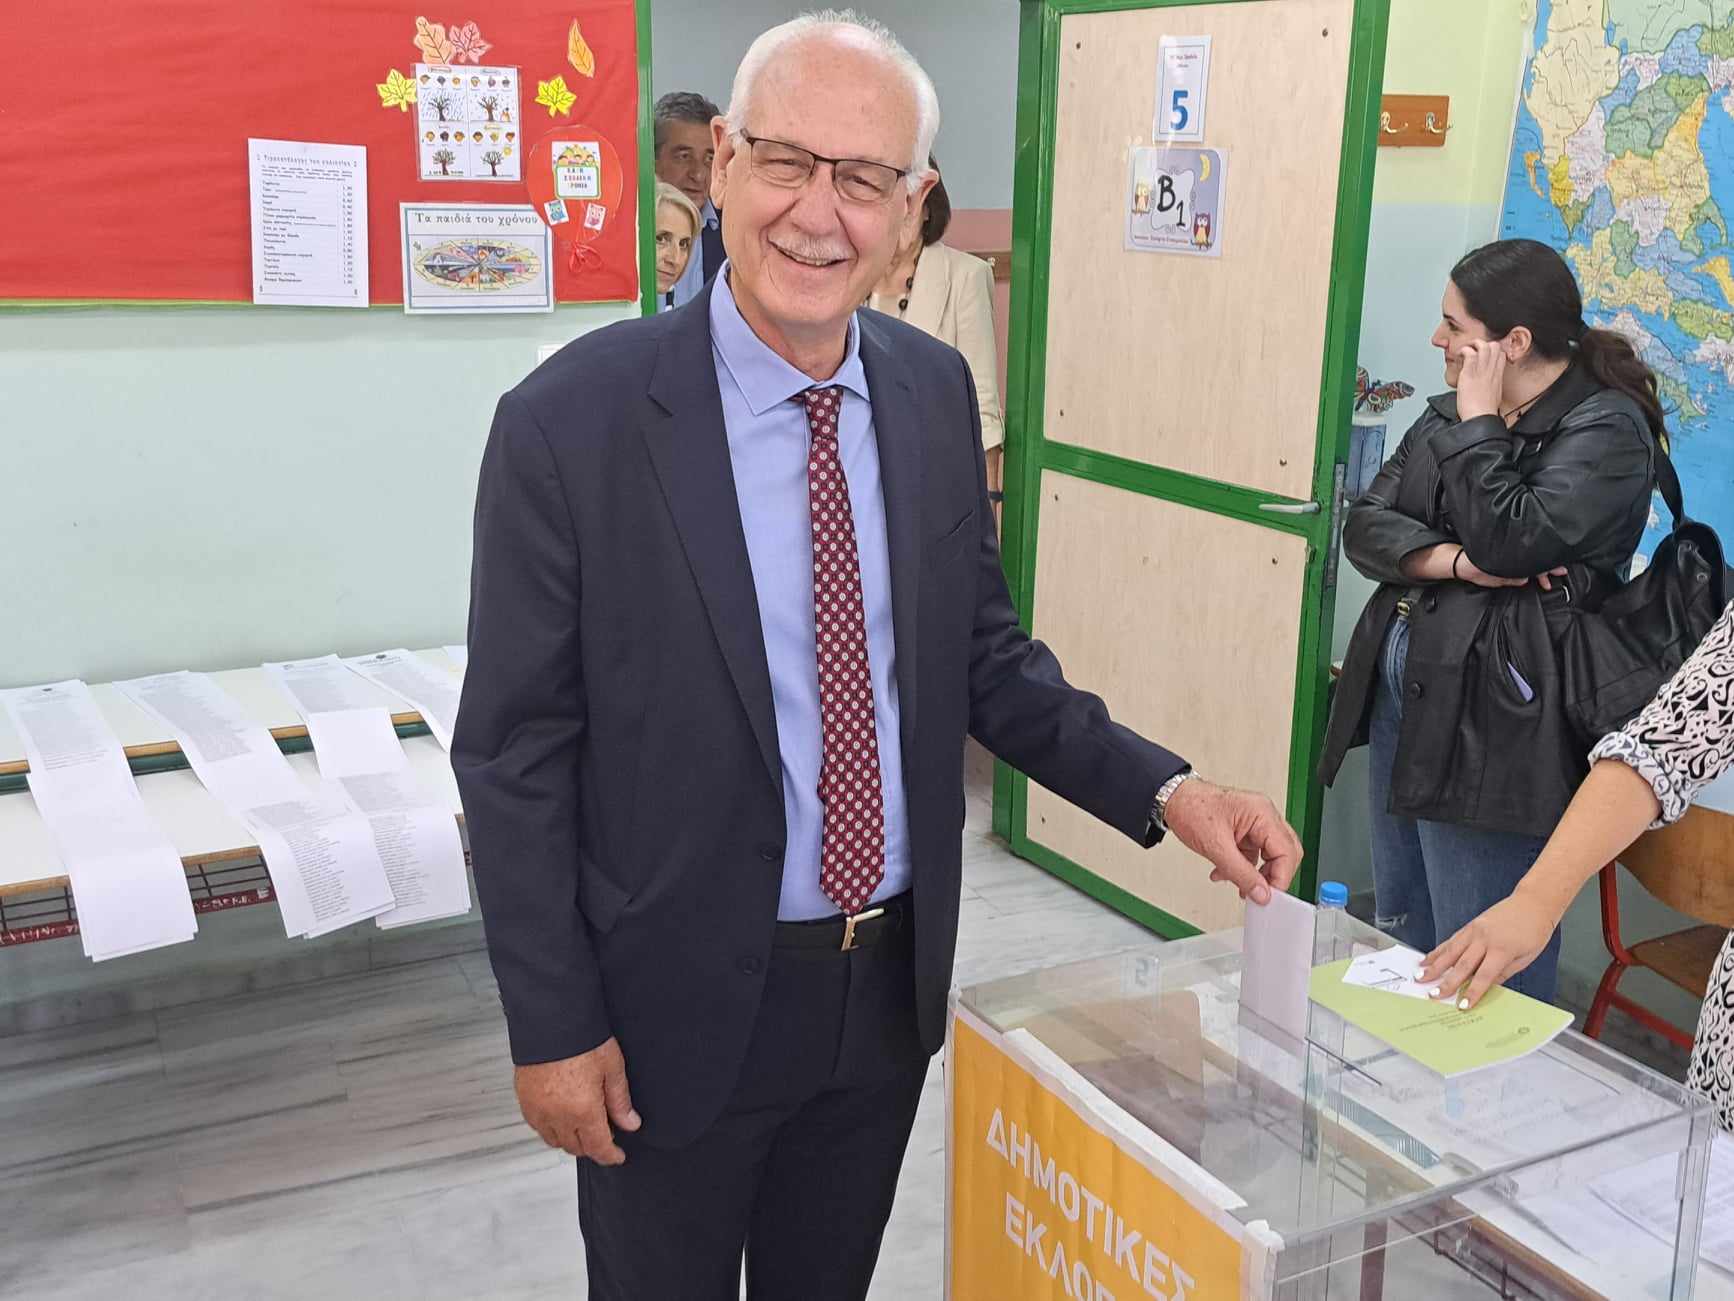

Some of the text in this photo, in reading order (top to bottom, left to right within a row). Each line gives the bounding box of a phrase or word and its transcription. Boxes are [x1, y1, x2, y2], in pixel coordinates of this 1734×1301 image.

[1170, 90, 1189, 131] 5
[414, 212, 538, 226] Τα παιδιά του χρόνου
